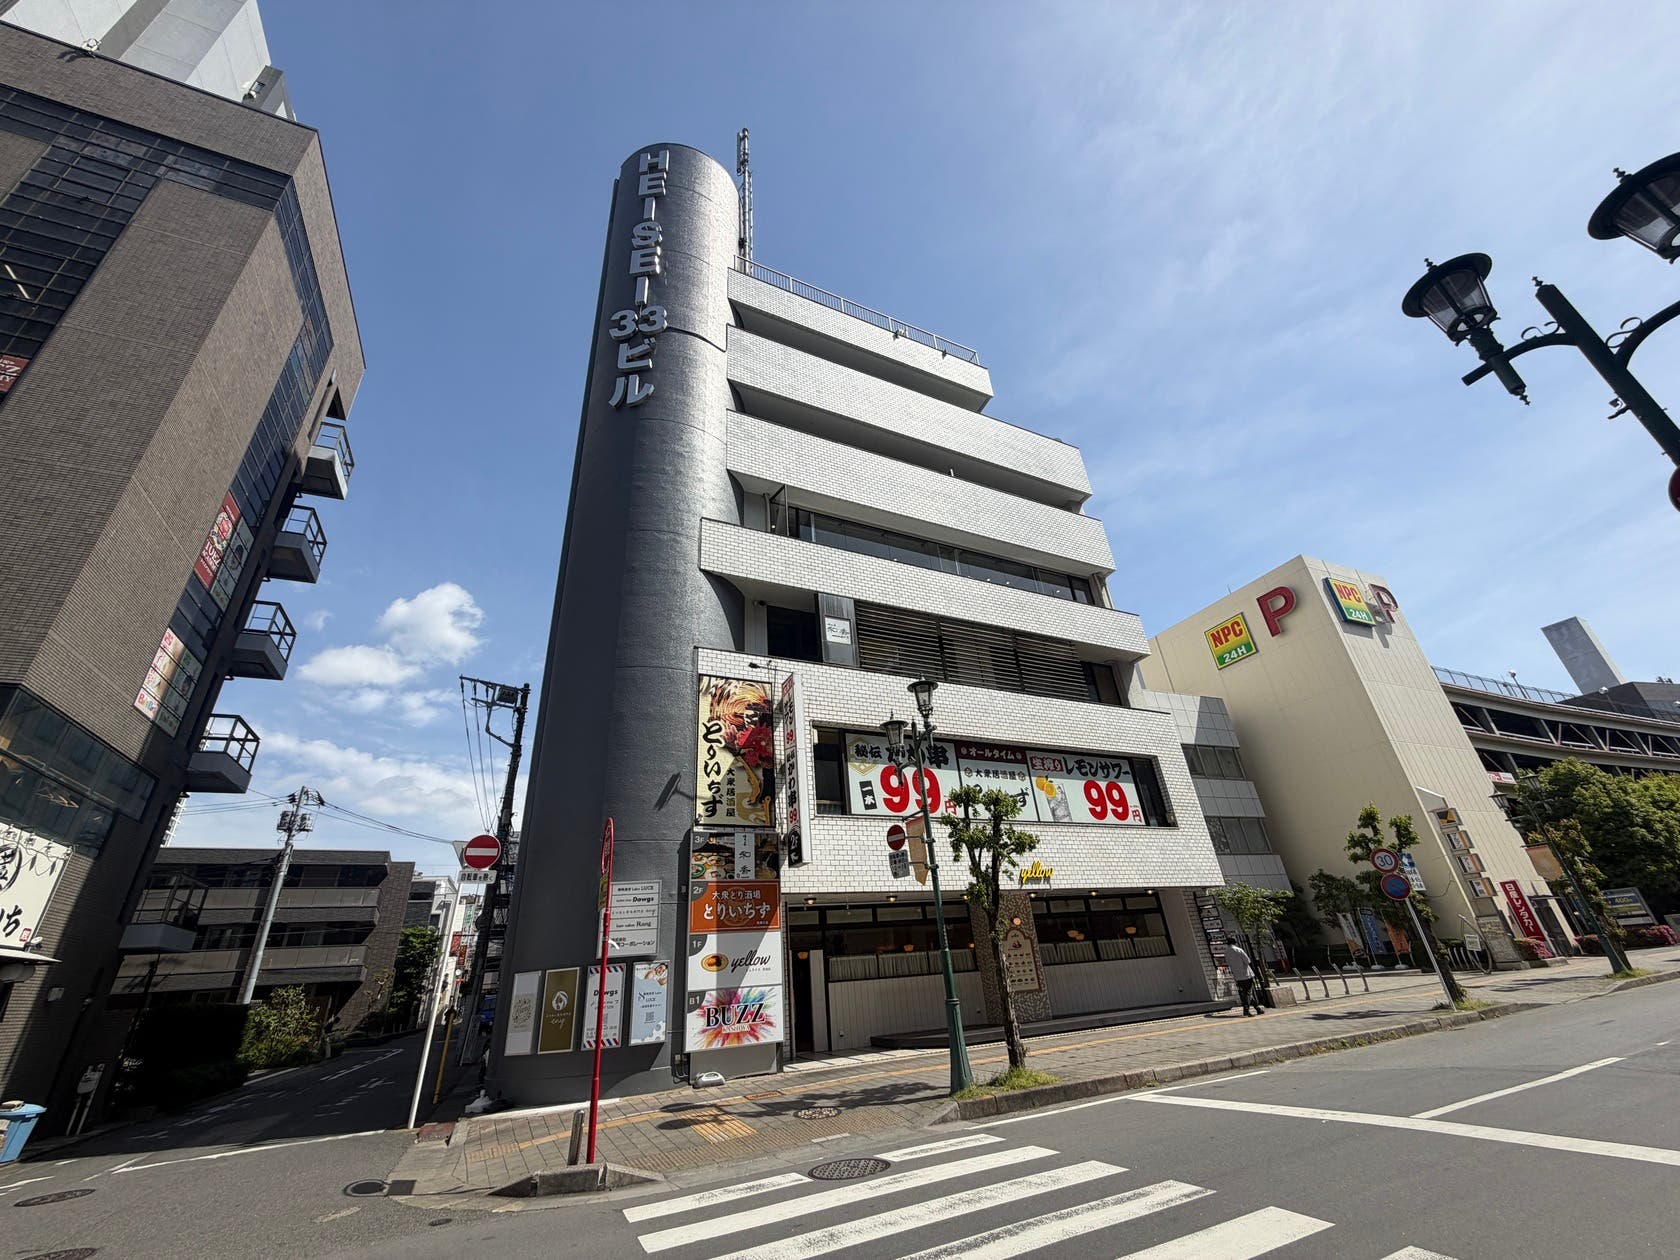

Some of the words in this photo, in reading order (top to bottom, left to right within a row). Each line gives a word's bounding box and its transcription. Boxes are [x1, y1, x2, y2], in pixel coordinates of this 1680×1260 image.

[1333, 582, 1361, 604] NPC
[1256, 586, 1297, 637] P
[1368, 583, 1398, 624] P
[1349, 608, 1369, 621] 24H
[1210, 620, 1244, 648] NPC
[1222, 645, 1248, 663] 24H
[855, 743, 882, 759] 秘伝
[969, 747, 1015, 760] オールタイム
[701, 722, 723, 818] とりいちず
[975, 768, 1017, 781] 大衆居酒屋
[1063, 756, 1131, 779] レモンサワー
[726, 767, 736, 817] 大衆居酒屋
[880, 765, 941, 814] 99
[1083, 779, 1130, 821] 99
[694, 835, 705, 844] 3F
[1376, 854, 1393, 867] 30
[1020, 860, 1054, 885] yellow
[692, 886, 704, 895] 2F
[712, 889, 761, 900] 大衆とり酒場
[703, 902, 771, 921] とりいちず
[692, 939, 702, 948] 1F
[731, 948, 771, 973] yellow
[593, 989, 618, 997] Dwgs
[689, 996, 701, 1005] B1
[705, 1002, 765, 1028] BUZZ
